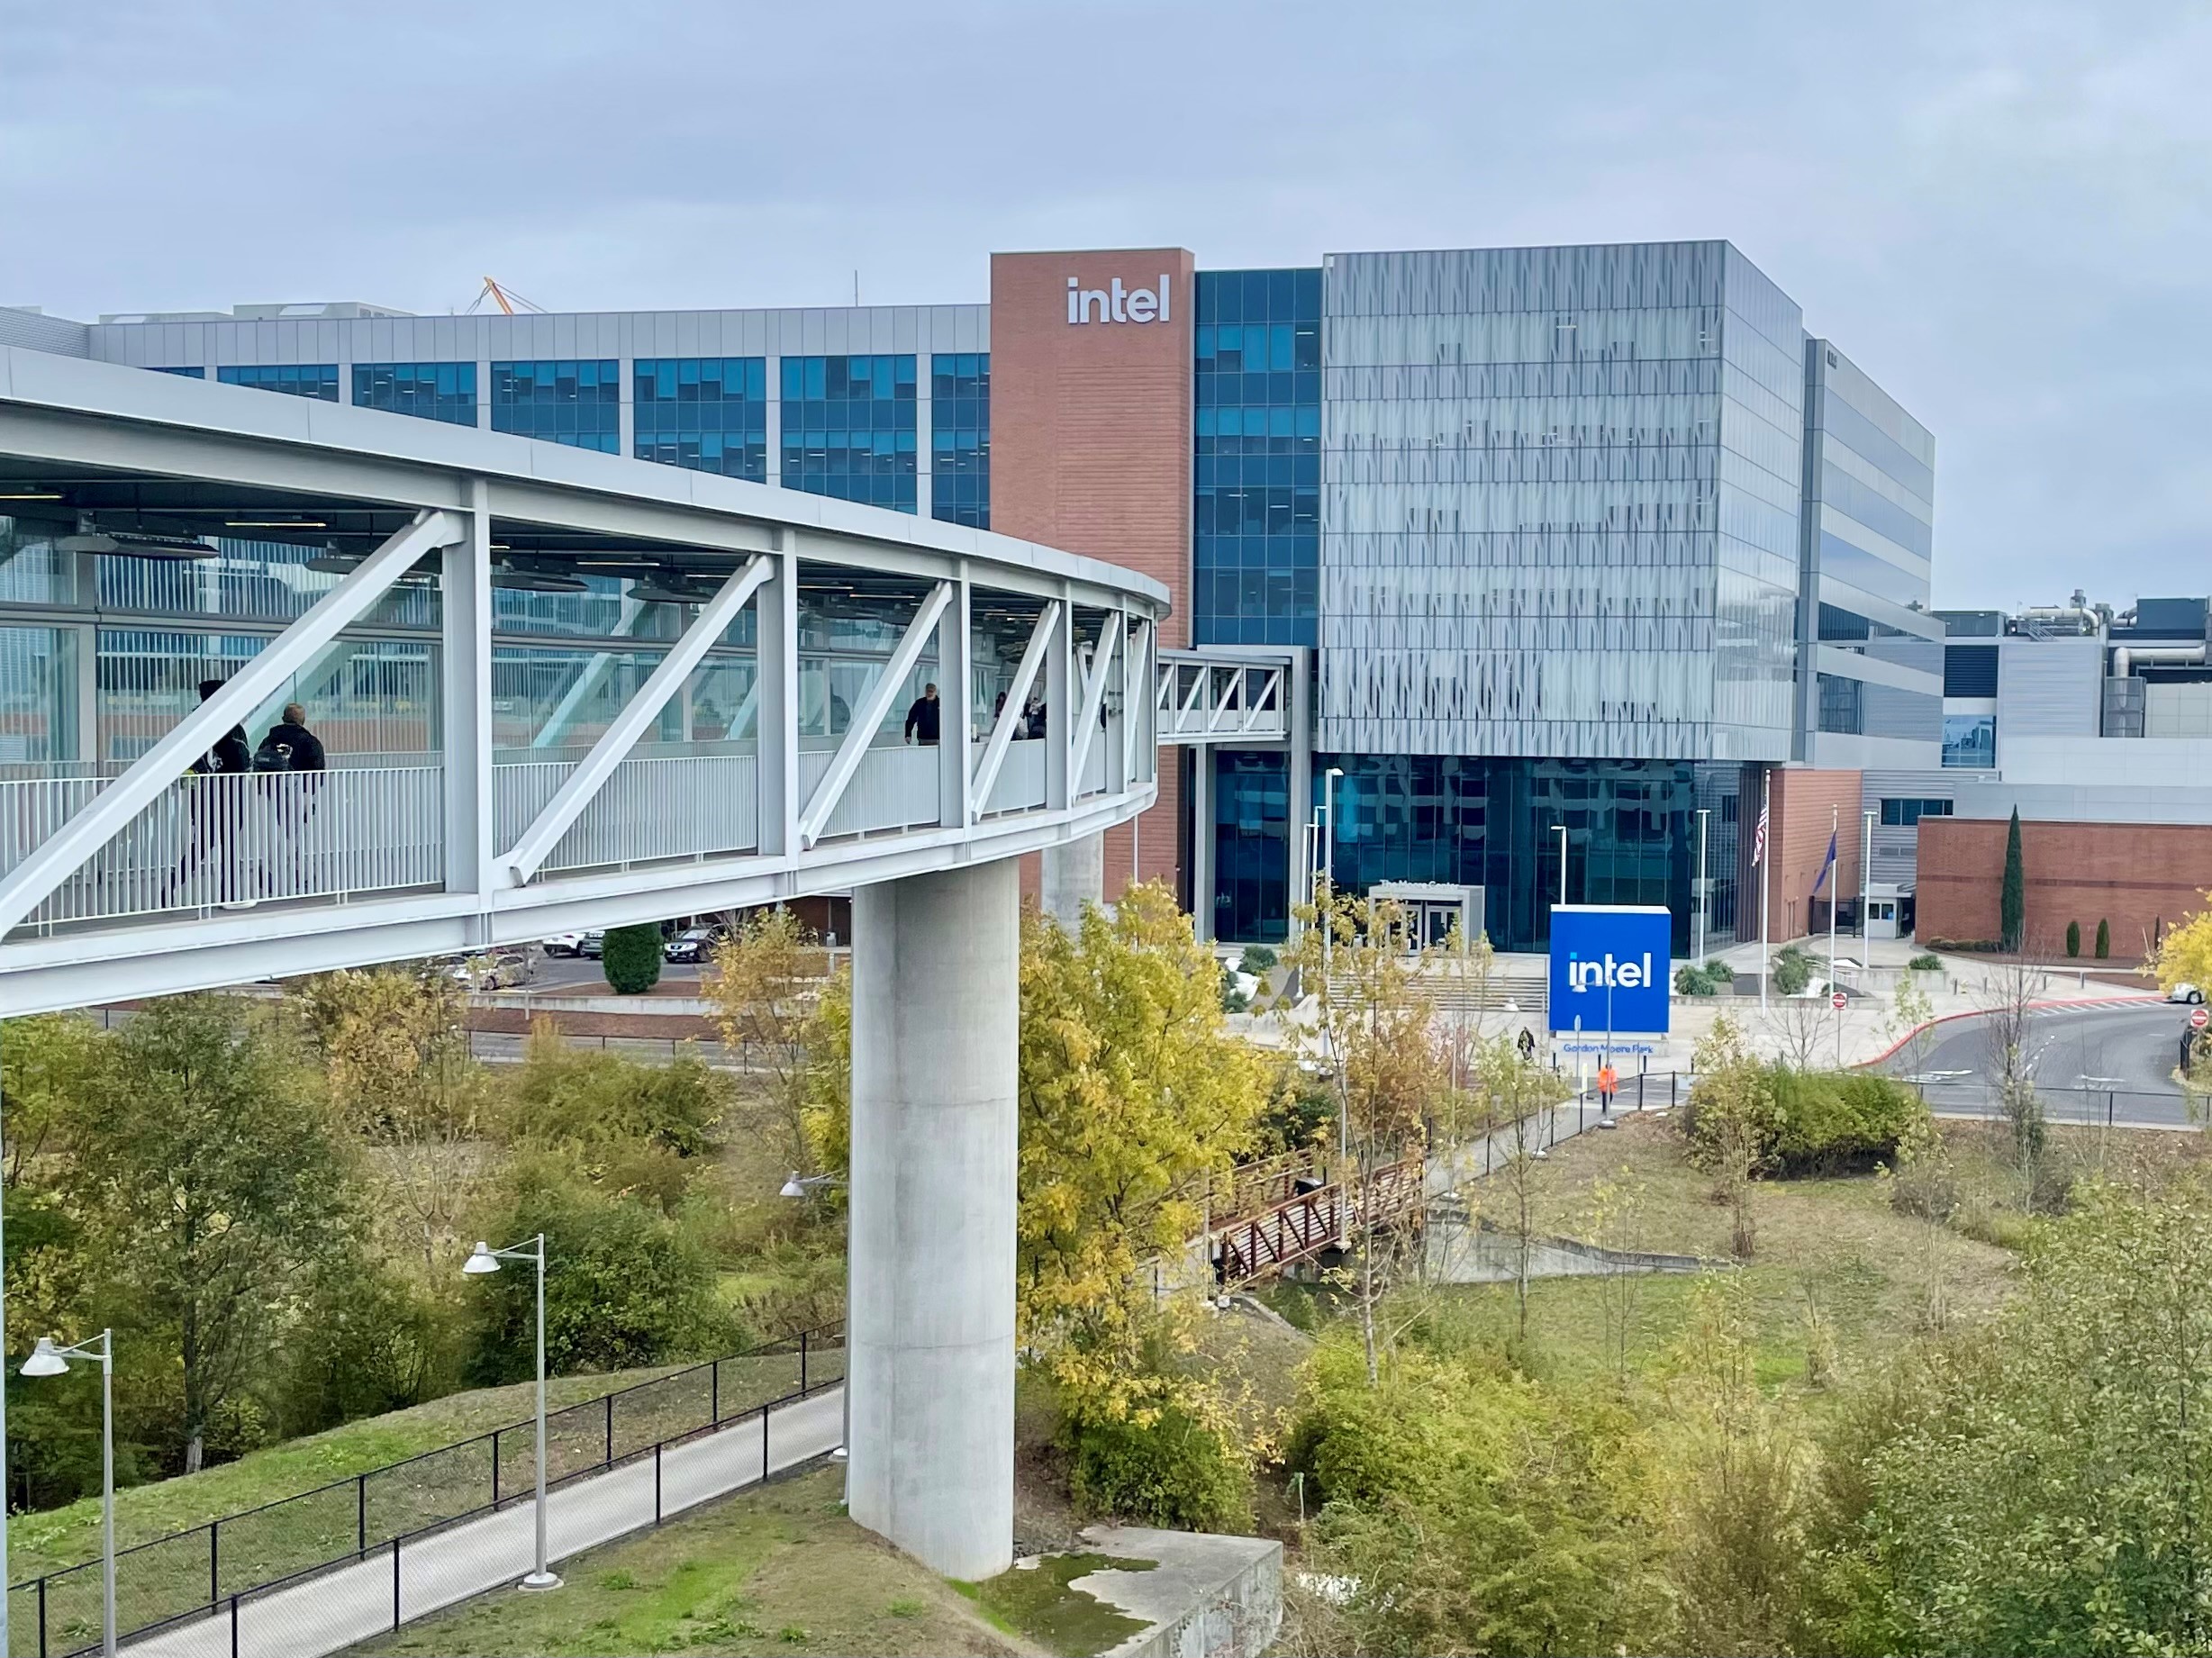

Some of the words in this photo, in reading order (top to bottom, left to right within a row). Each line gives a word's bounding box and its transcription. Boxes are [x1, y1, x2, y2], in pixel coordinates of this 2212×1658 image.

[1067, 274, 1170, 324] intel
[1569, 952, 1652, 988] intel
[1564, 1044, 1599, 1053] Gordon
